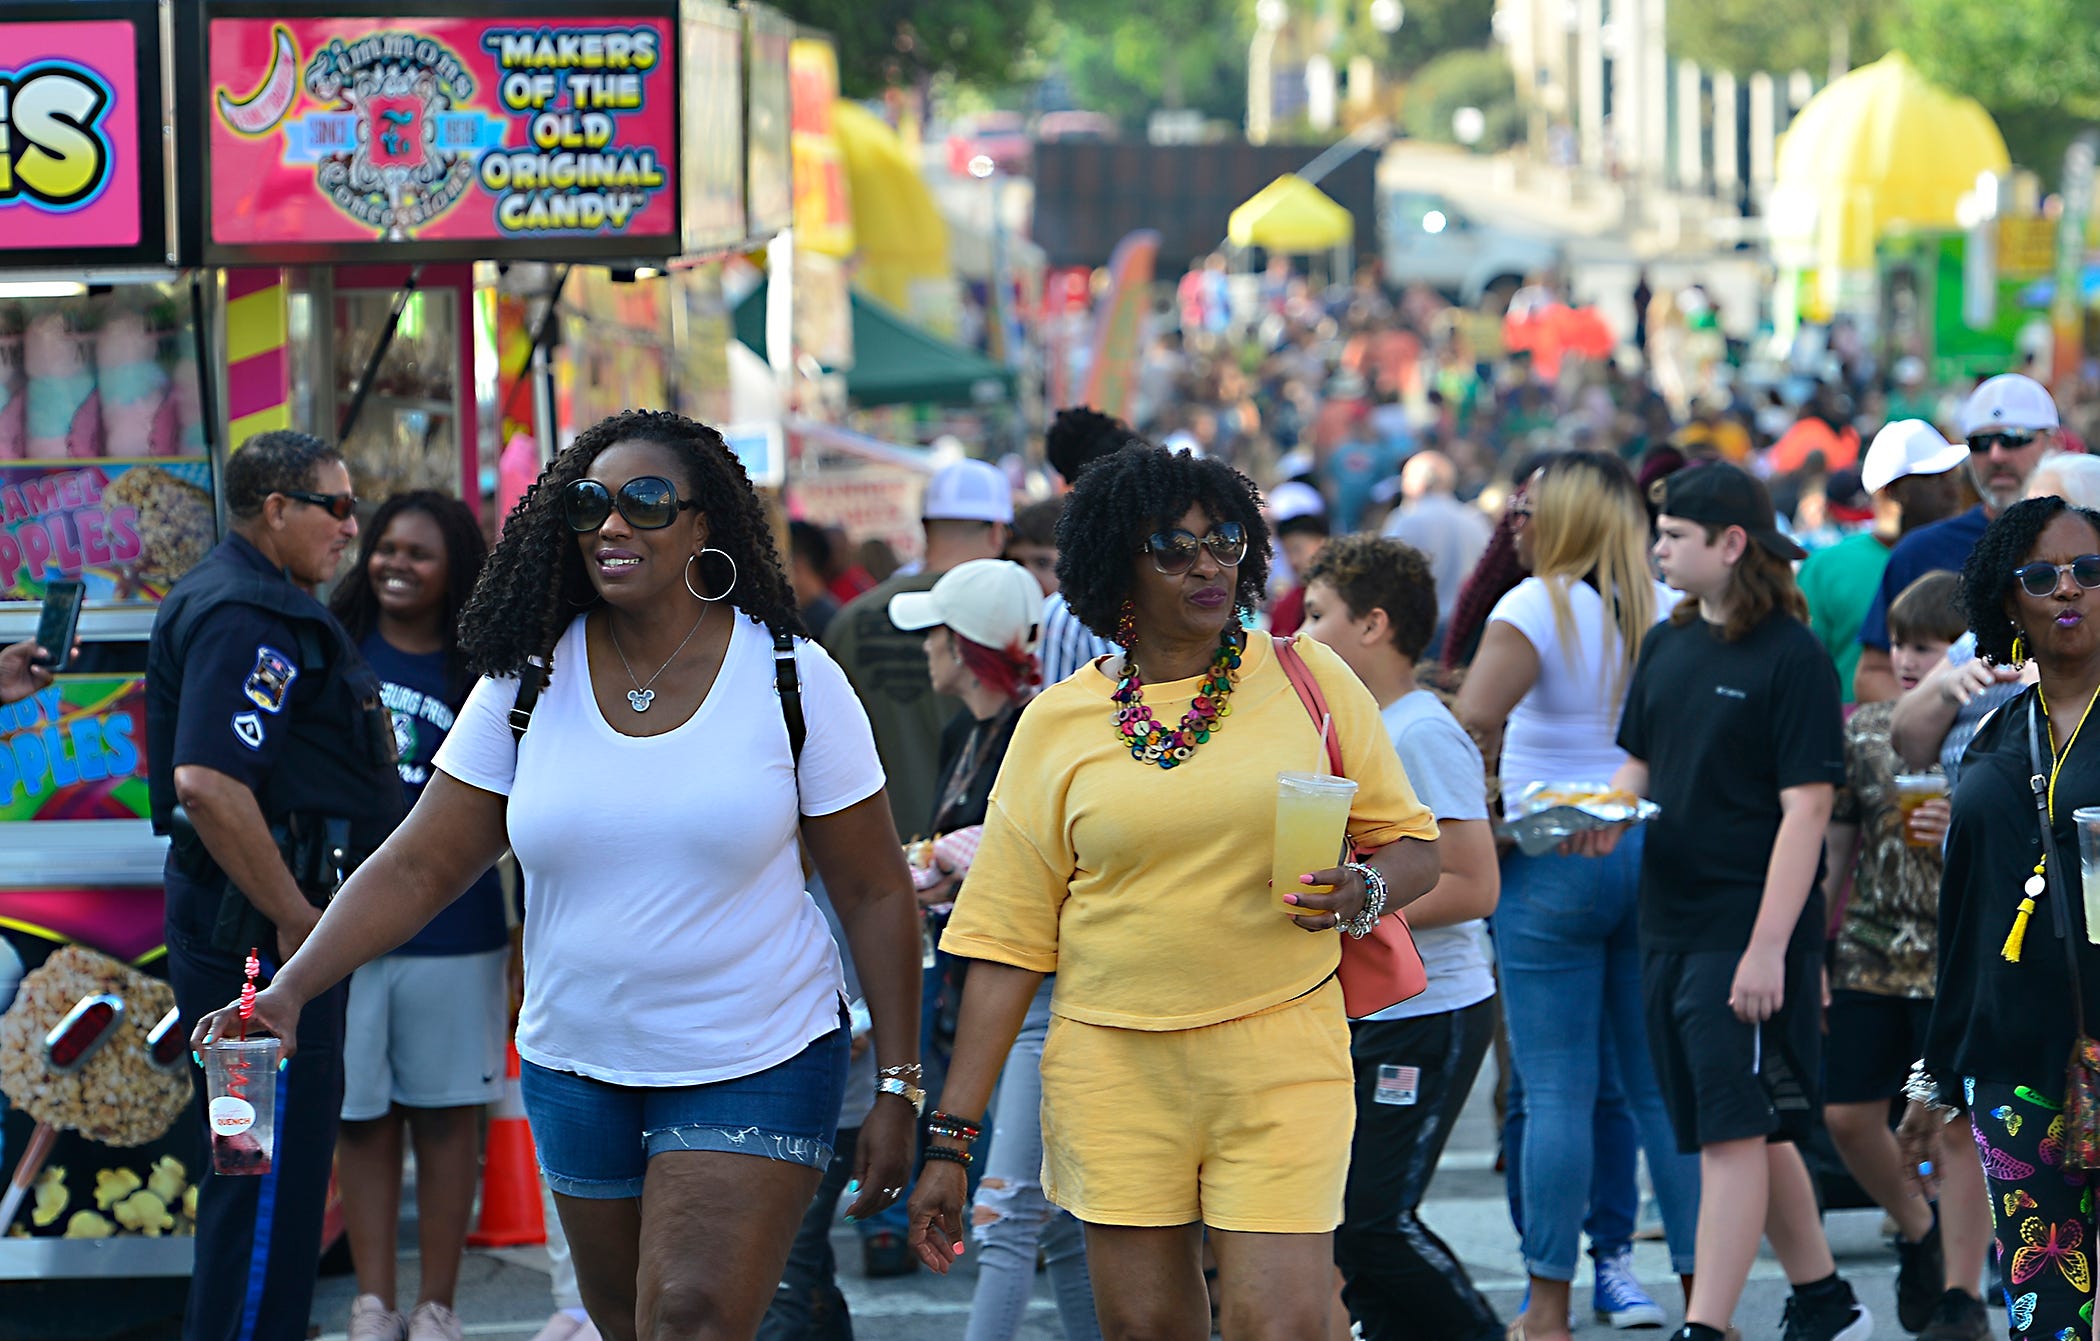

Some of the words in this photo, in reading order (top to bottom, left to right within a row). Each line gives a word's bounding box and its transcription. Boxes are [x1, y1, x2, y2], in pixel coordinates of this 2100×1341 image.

[503, 73, 555, 109] OF
[568, 74, 641, 109] THE
[0, 75, 99, 196] S
[533, 113, 612, 149] OLD
[481, 152, 663, 189] ORIGINAL
[0, 471, 102, 525] AMEL
